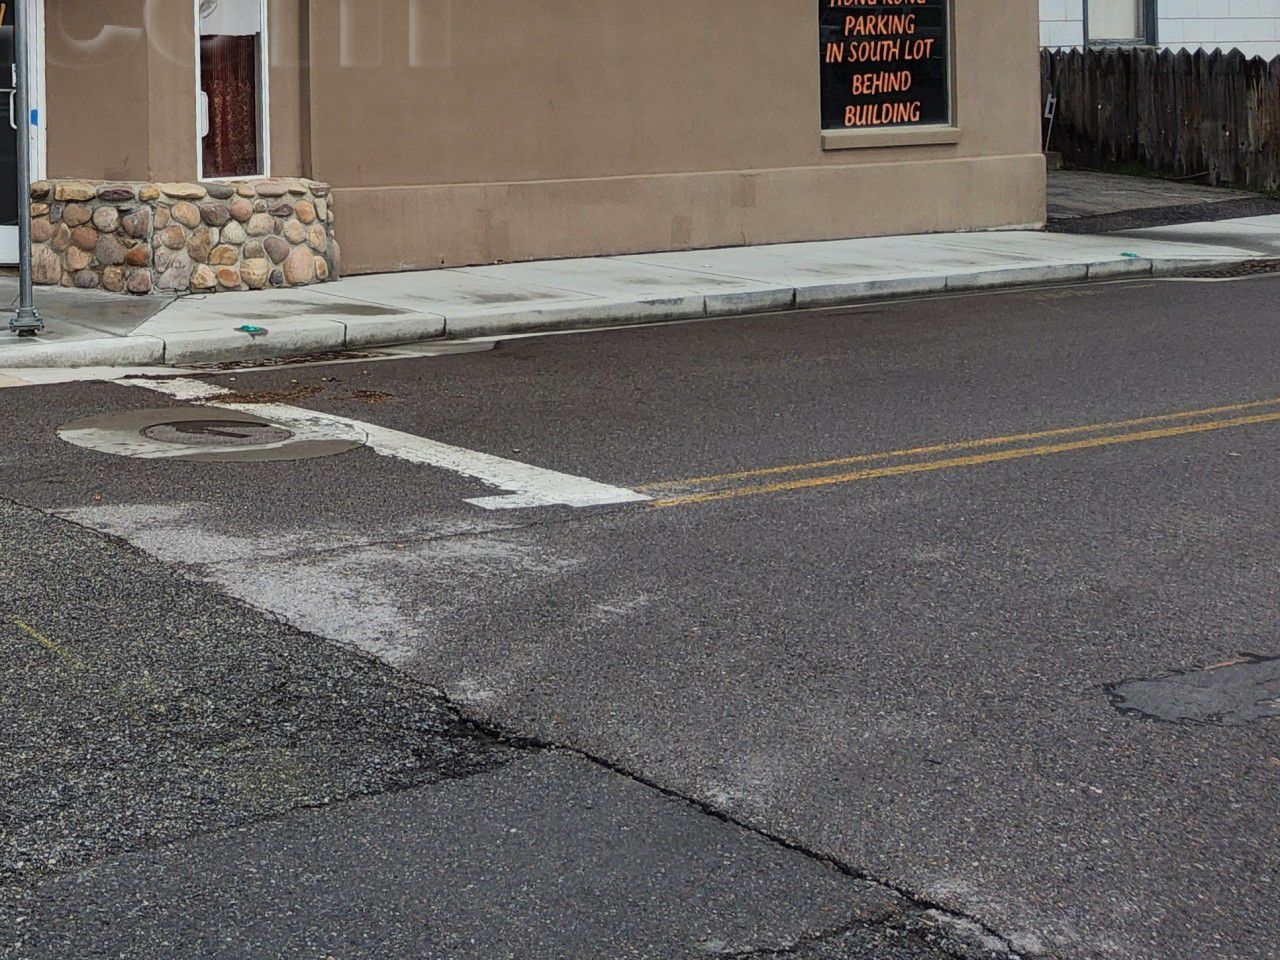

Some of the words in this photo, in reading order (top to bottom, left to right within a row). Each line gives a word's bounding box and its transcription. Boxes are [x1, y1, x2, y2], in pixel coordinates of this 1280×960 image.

[844, 14, 916, 36] PARKING
[825, 42, 844, 63] IN
[847, 38, 900, 62] SOUTH
[904, 39, 934, 60] LOT
[852, 70, 912, 95] BEHIND
[844, 101, 921, 126] BUILDING
